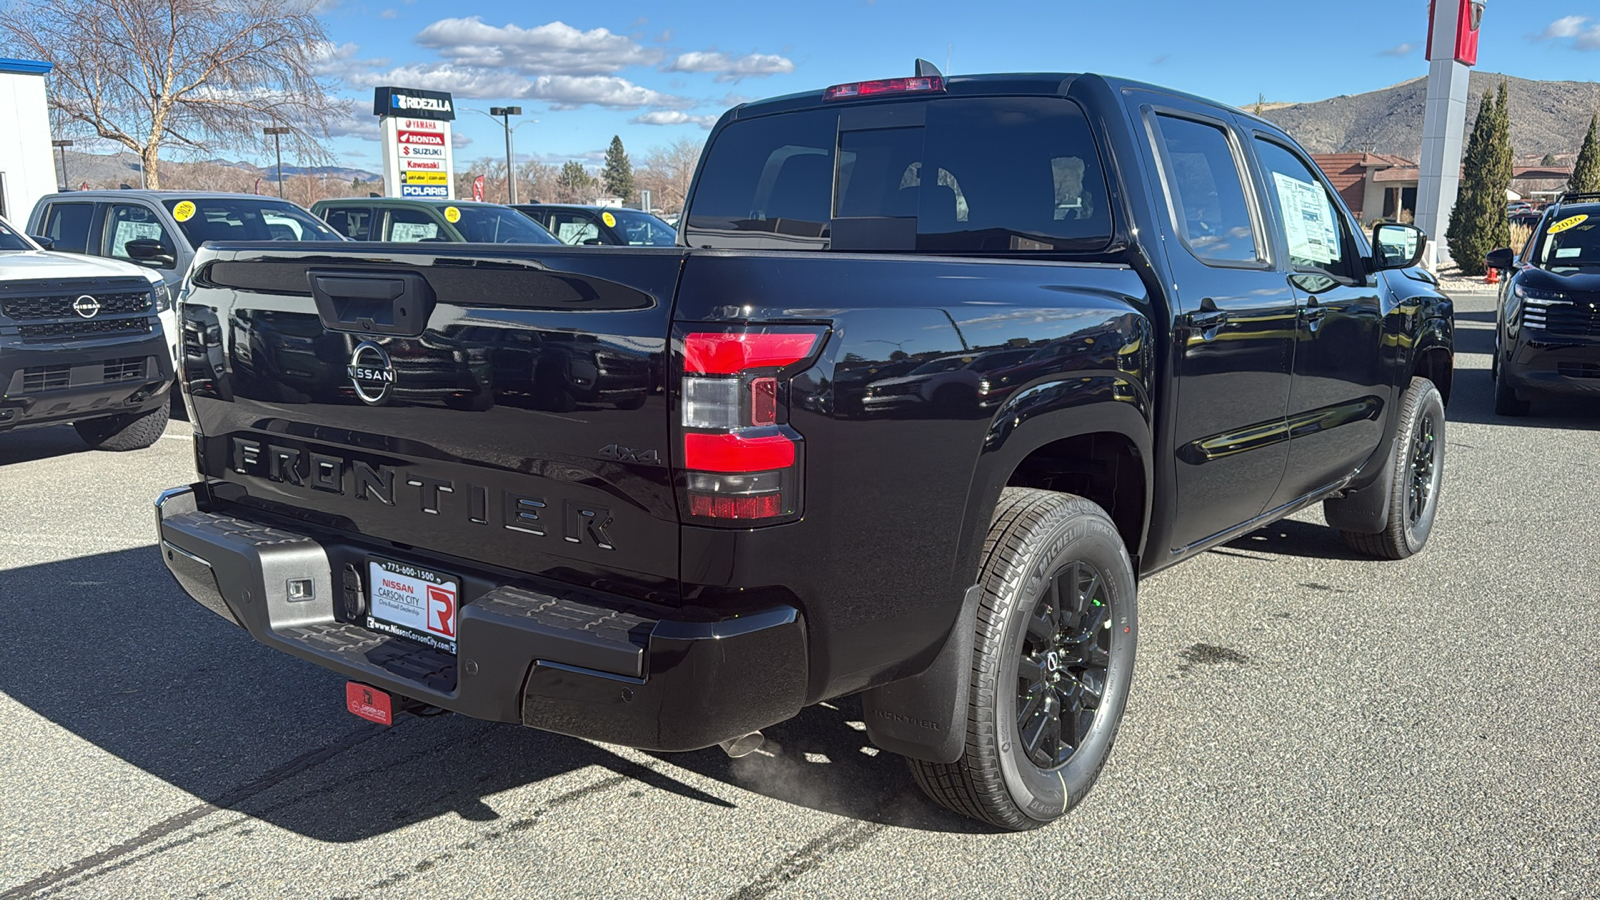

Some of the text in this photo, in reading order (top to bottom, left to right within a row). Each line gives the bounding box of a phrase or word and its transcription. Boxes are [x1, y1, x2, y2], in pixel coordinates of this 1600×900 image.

[406, 97, 451, 111] RIDEZILLA
[412, 121, 436, 129] YAMAHA
[408, 135, 442, 143] HONDA
[412, 147, 442, 156] SUZUKI
[407, 161, 440, 169] Kawasaki
[403, 186, 447, 195] POLARIS
[1555, 217, 1581, 230] 2026
[347, 366, 394, 382] NISSAN
[232, 436, 617, 551] FRONTIER
[387, 562, 435, 582] 775-600-1500
[382, 578, 414, 594] NISSAN
[378, 587, 420, 606] CARSON CITY
[374, 621, 450, 651] www.NissanCarsonCity.com
